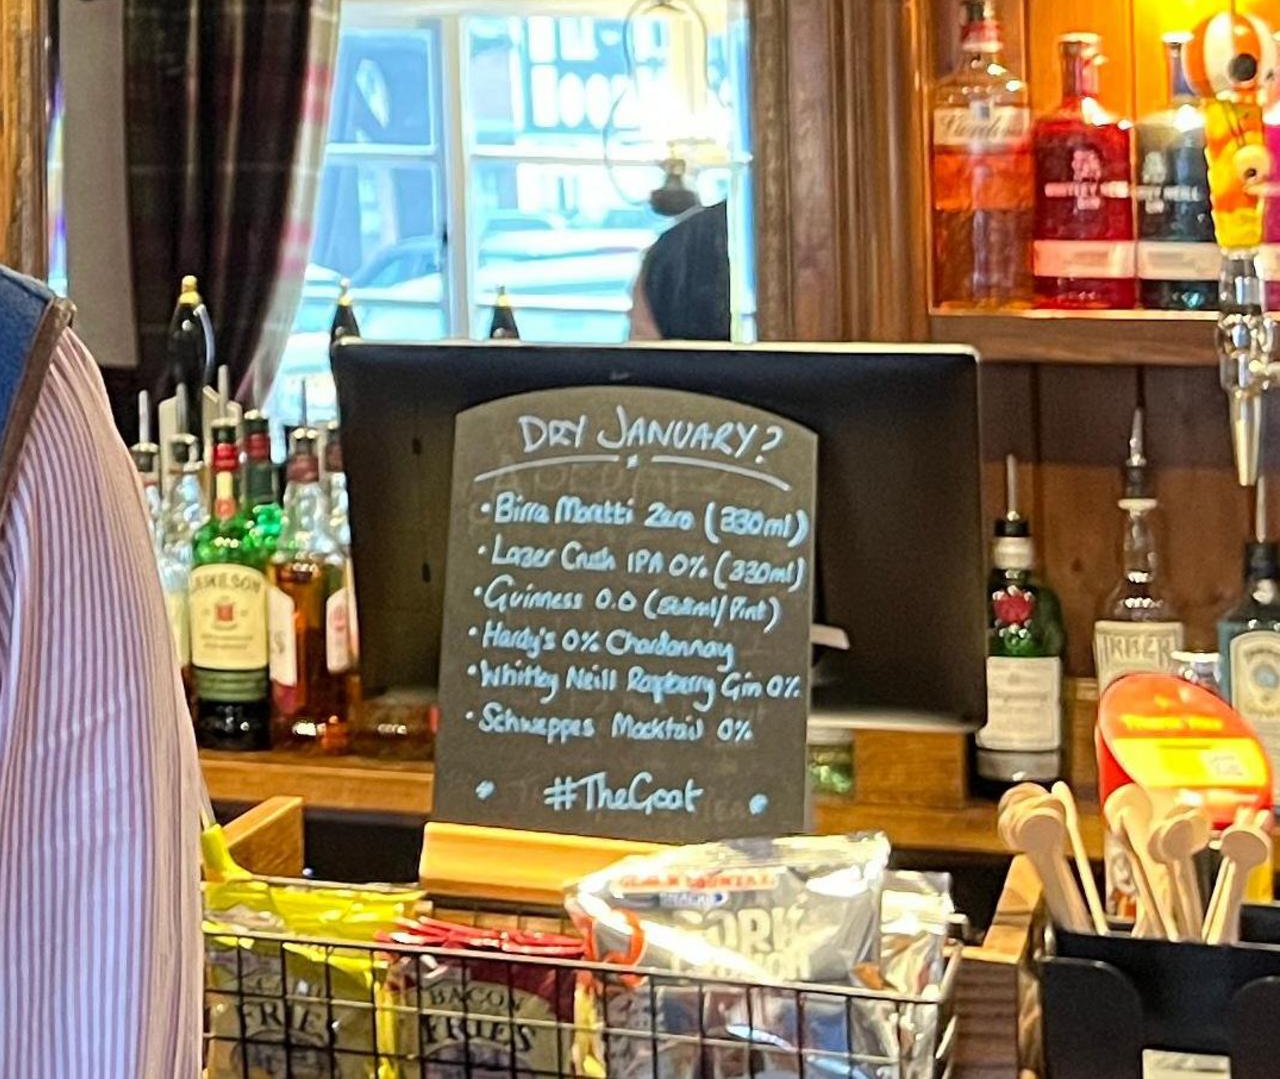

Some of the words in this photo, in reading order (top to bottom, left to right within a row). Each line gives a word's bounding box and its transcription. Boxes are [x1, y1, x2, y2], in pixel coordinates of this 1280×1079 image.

[518, 415, 587, 453] DRY
[597, 405, 784, 464] JANUARY?
[494, 491, 549, 524] Birra
[561, 540, 616, 571] Crush
[627, 549, 665, 575] IPA
[595, 586, 638, 611] 0.0
[482, 620, 556, 659] Hardy's
[562, 629, 600, 653] 0%
[606, 627, 736, 673] Chardonnay
[565, 664, 618, 692] Neill
[721, 671, 763, 702] Gin
[766, 674, 802, 699] 0%
[716, 718, 753, 742] 0%
[543, 771, 705, 816] #TheGoat
